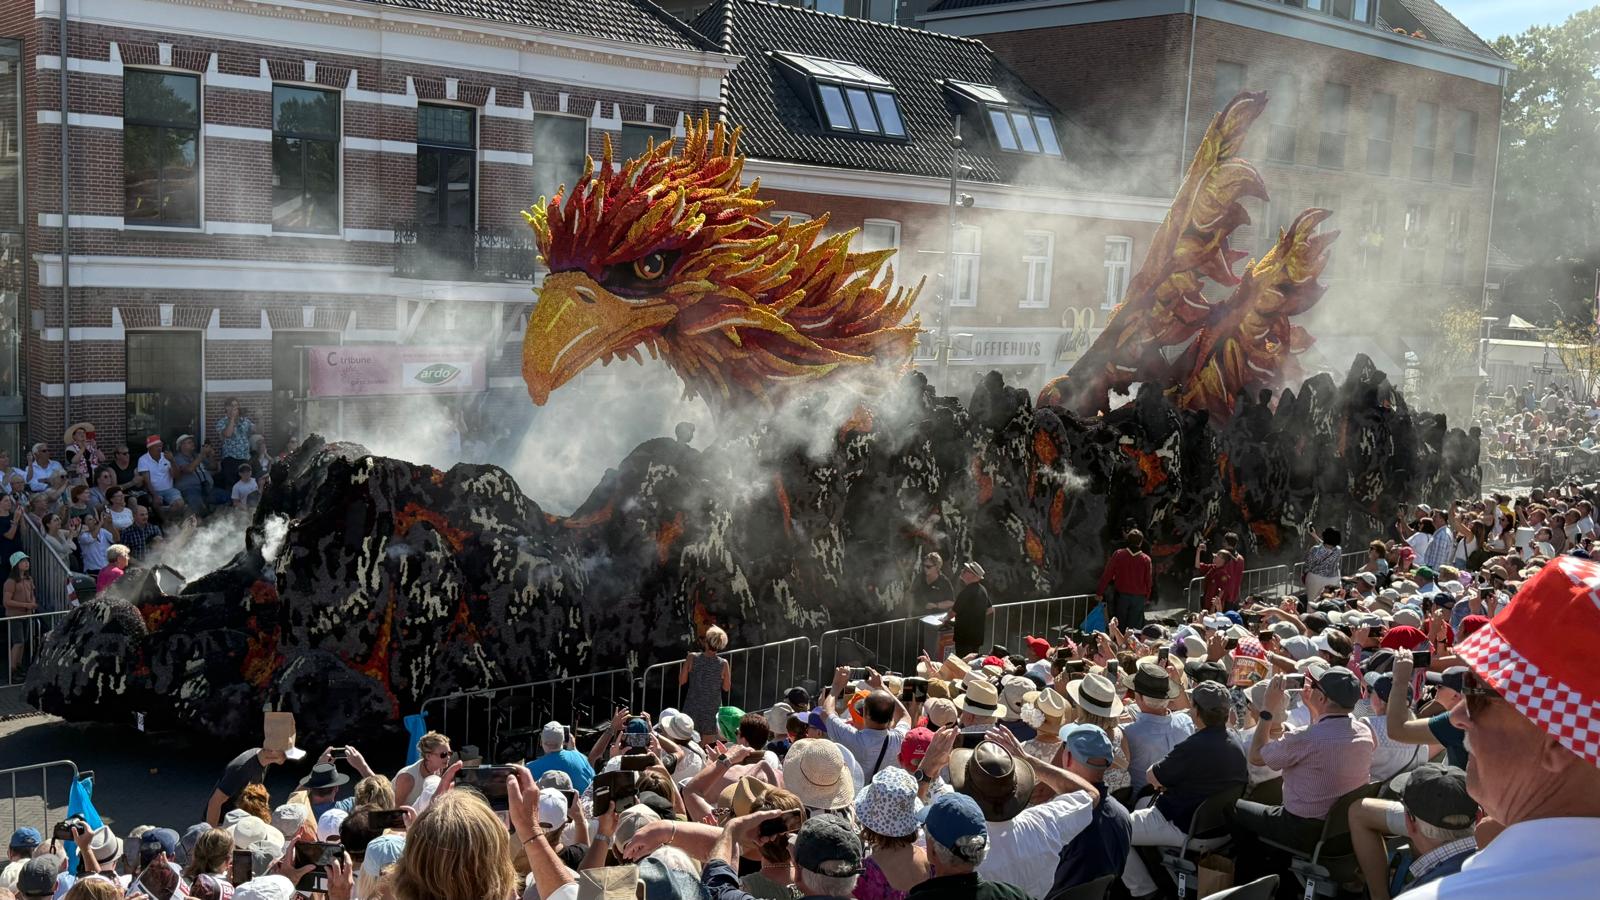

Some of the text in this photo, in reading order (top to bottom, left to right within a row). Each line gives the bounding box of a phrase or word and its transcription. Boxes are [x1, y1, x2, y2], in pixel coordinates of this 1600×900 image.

[966, 341, 1041, 357] OFFIEHUYS
[327, 351, 372, 366] C tribune
[420, 367, 450, 379] ardo
